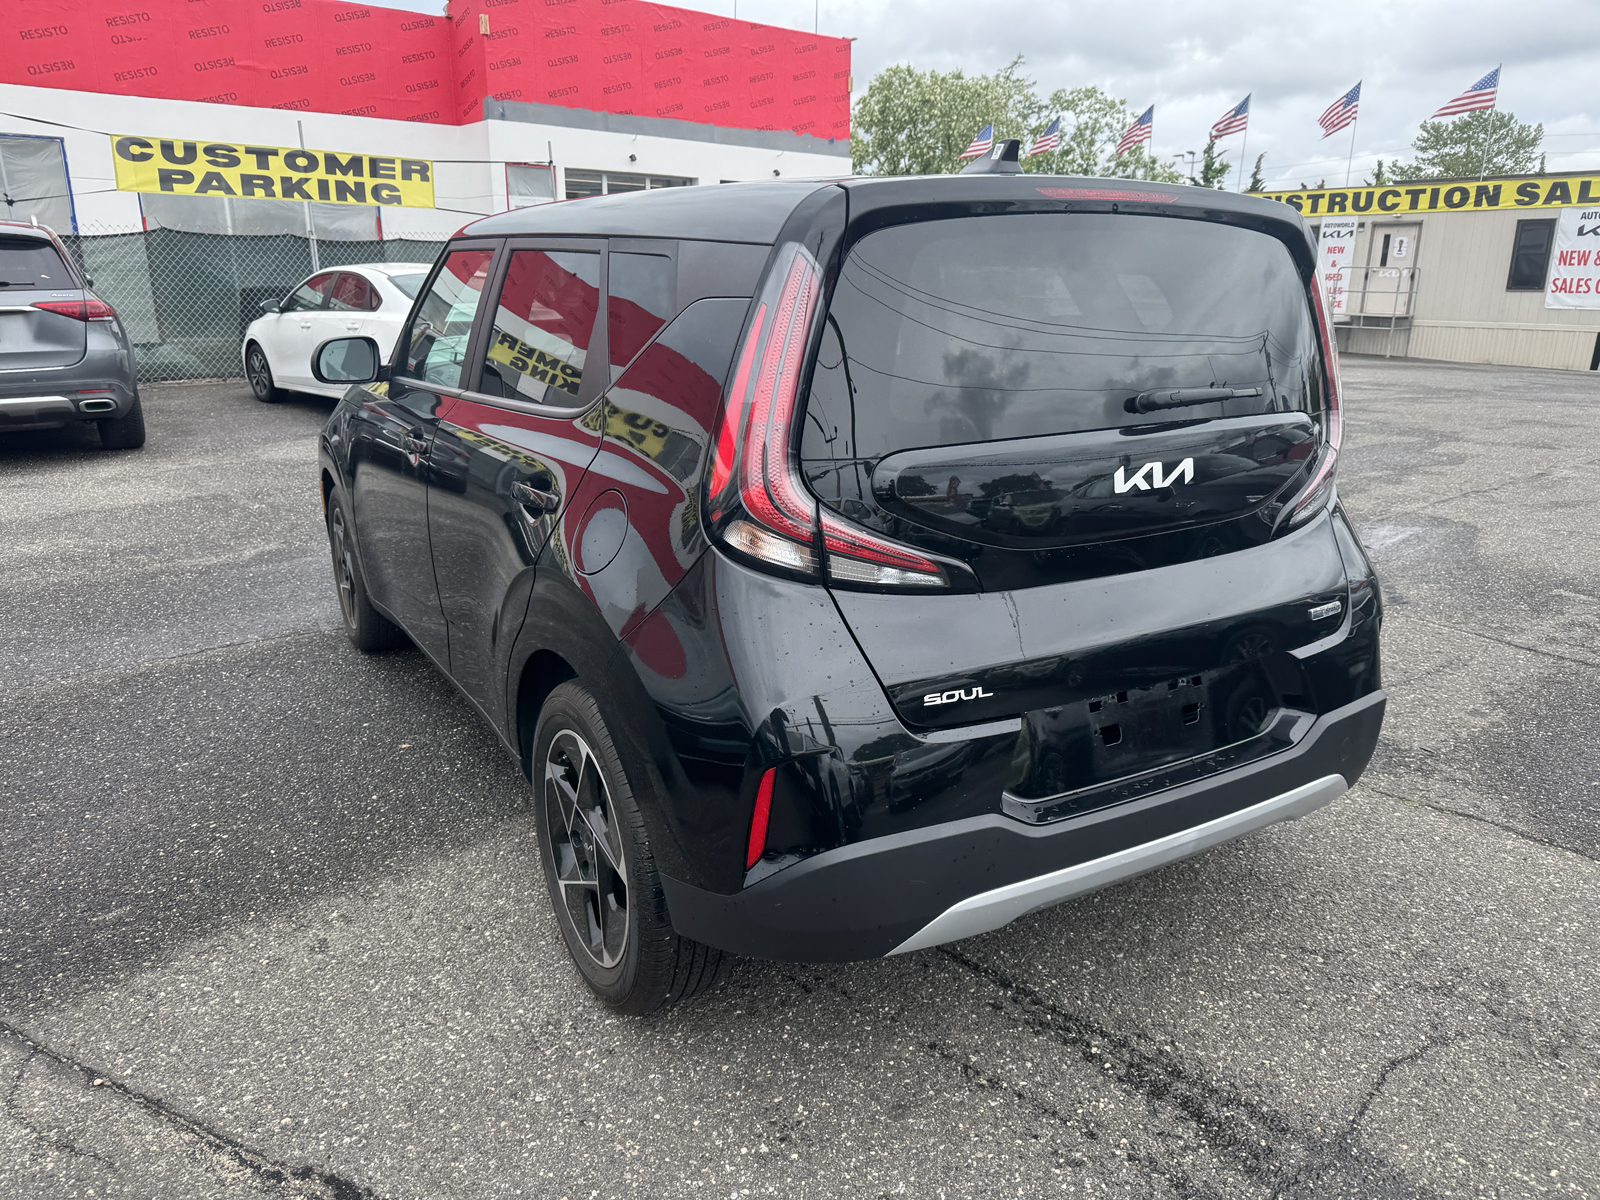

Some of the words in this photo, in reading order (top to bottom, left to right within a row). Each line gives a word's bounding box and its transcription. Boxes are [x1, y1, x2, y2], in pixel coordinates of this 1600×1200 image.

[105, 12, 151, 27] RESISTO
[334, 9, 371, 22] RESISTO
[188, 25, 230, 39] RESISTO
[401, 19, 435, 32] RESISTO
[601, 24, 631, 36] RESISTO
[653, 21, 682, 33] RESISTO
[703, 20, 730, 32] RESISTO
[19, 25, 69, 41] RESISTO
[545, 26, 576, 39] RESISTO
[264, 34, 304, 48] RESISTO
[335, 43, 372, 56] RESISTO
[655, 48, 683, 60] RESISTO
[704, 46, 731, 58] RESISTO
[750, 44, 775, 56] RESISTO
[794, 44, 818, 55] RESISTO
[401, 51, 436, 64] RESISTO
[489, 57, 522, 71] RESISTO
[548, 55, 578, 68] RESISTO
[603, 52, 632, 64] RESISTO
[27, 60, 76, 76] RESISTO
[194, 57, 236, 72] RESISTO
[113, 66, 158, 82] RESISTO
[270, 65, 309, 80] RESISTO
[749, 72, 774, 84] RESISTO
[792, 71, 816, 82] RESISTO
[340, 72, 376, 87] RESISTO
[405, 79, 439, 93] RESISTO
[654, 77, 682, 90] RESISTO
[703, 75, 729, 87] RESISTO
[492, 89, 522, 101] ESISTO
[548, 86, 579, 99] RESISTO
[603, 82, 632, 95] RESISTO
[704, 101, 731, 112] RESISTO
[750, 97, 775, 109] RESISTO
[793, 95, 817, 107] RESISTO
[656, 103, 684, 116] RESISTO
[115, 136, 430, 183] CUSTOMER
[157, 168, 402, 206] PARKING
[1322, 229, 1354, 239] KIA
[1327, 246, 1345, 255] NEW
[1558, 250, 1591, 266] NEW
[1551, 277, 1592, 294] SALES
[1113, 457, 1194, 494] KIA
[923, 686, 994, 706] SOUL
